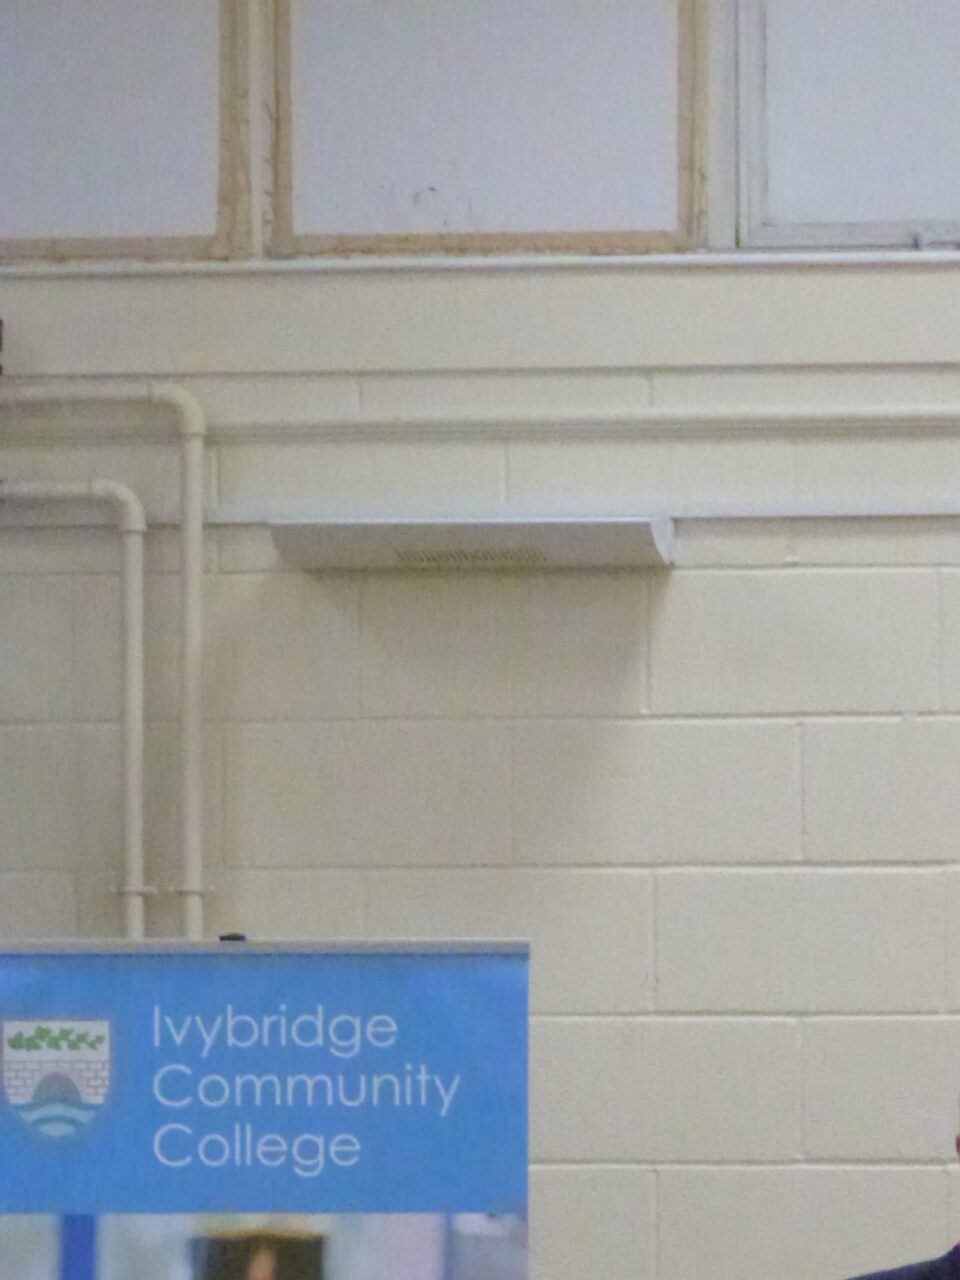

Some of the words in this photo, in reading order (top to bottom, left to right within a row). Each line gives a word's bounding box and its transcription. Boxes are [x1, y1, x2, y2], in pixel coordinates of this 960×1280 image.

[153, 1004, 398, 1057] Ivybridge
[153, 1063, 461, 1116] Community
[153, 1123, 362, 1177] College
